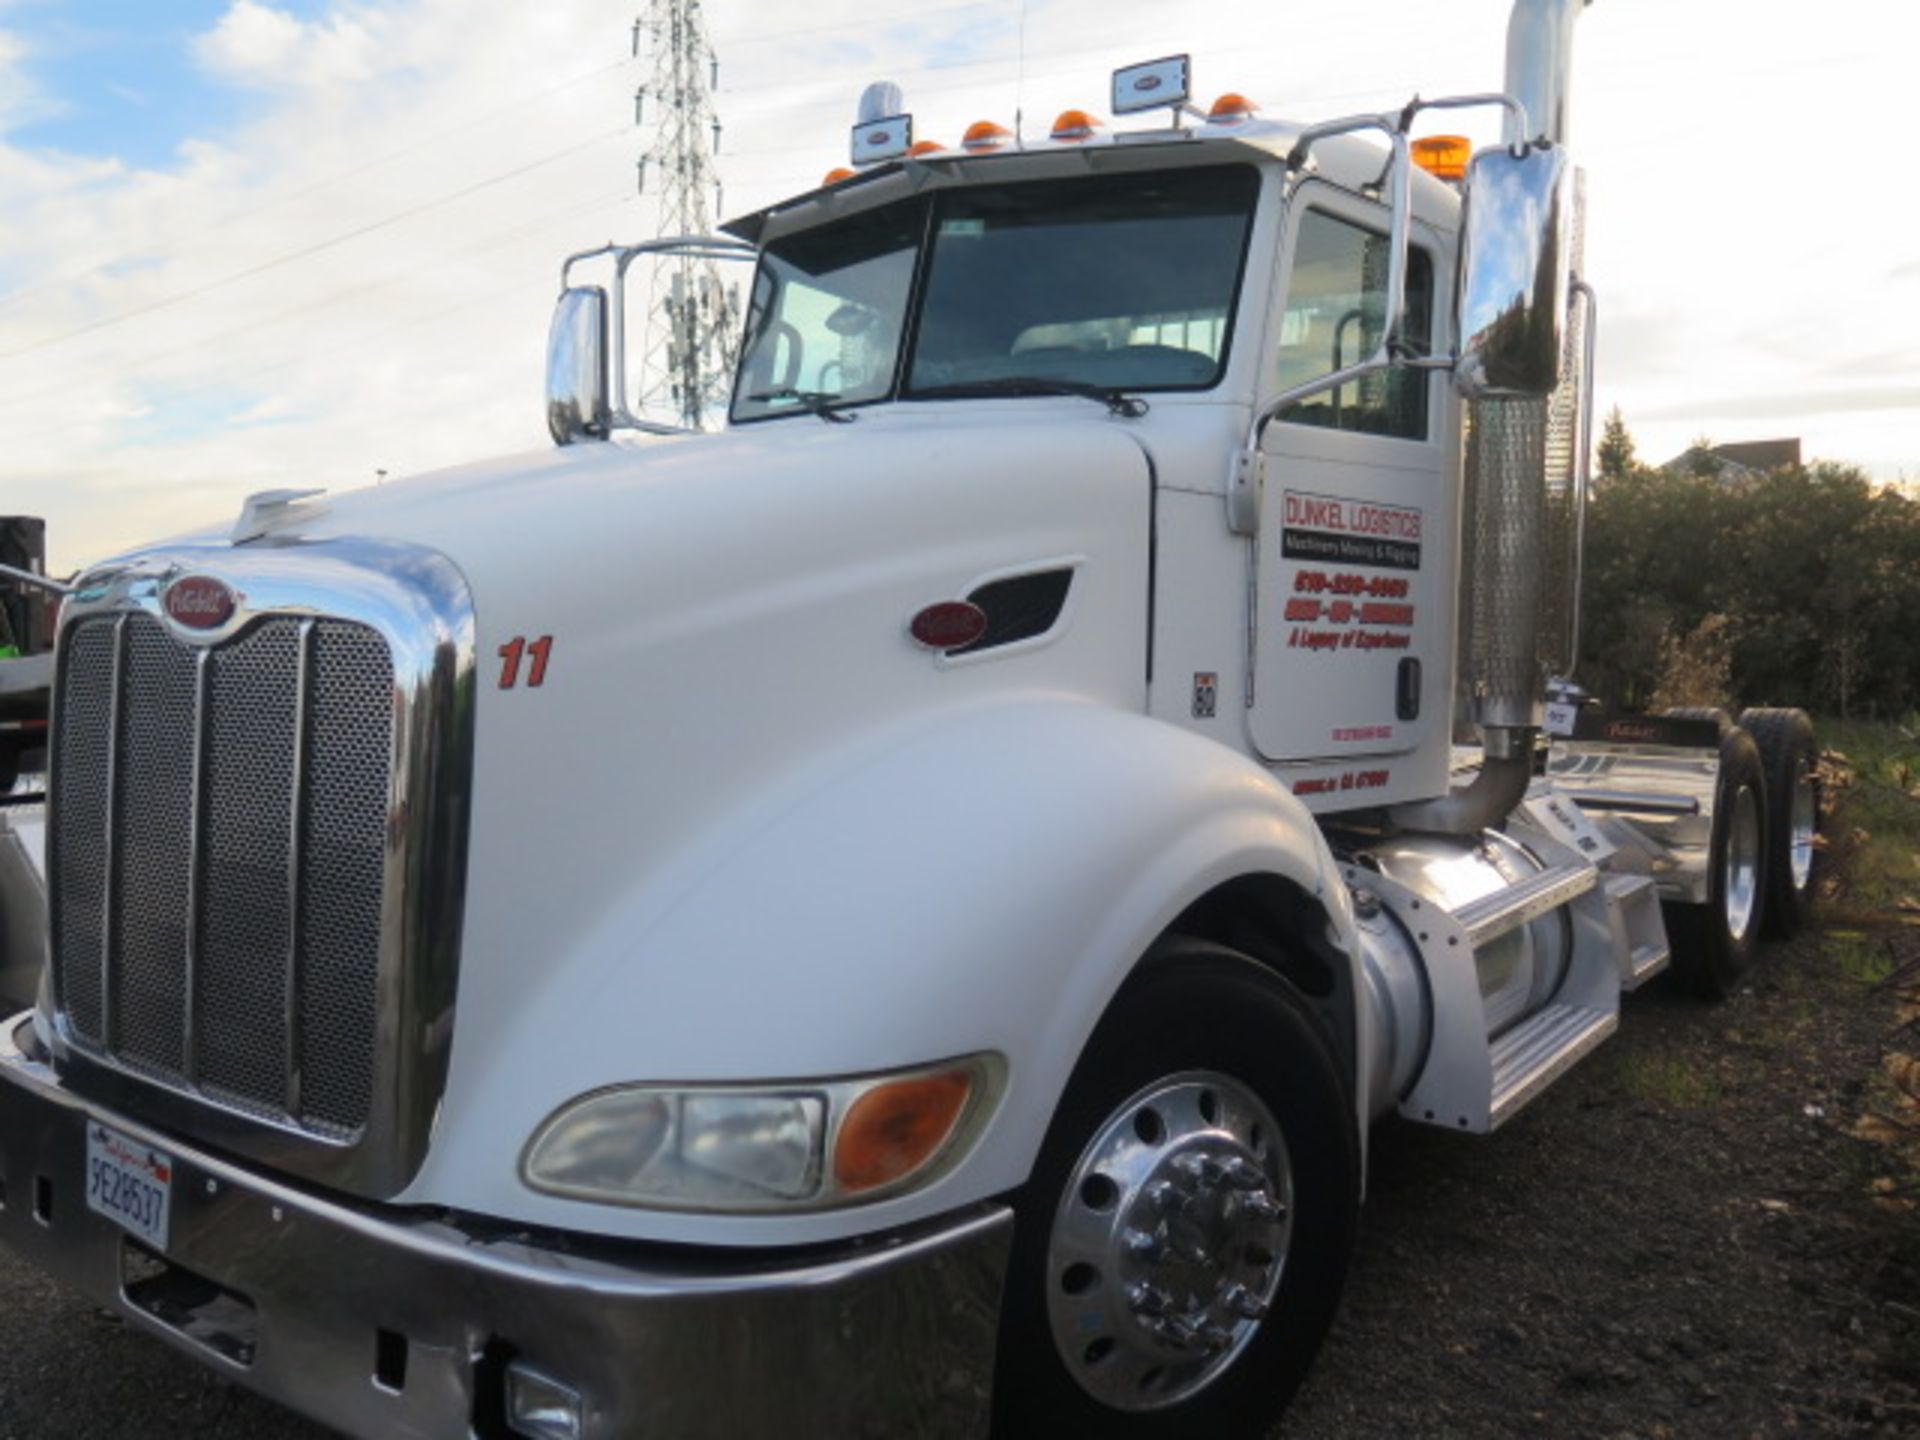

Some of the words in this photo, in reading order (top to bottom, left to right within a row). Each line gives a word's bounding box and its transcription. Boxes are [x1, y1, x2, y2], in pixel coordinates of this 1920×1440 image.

[1286, 496, 1346, 529] DUNKEL
[1350, 506, 1420, 538] LOGISTICS
[497, 634, 553, 690] 11
